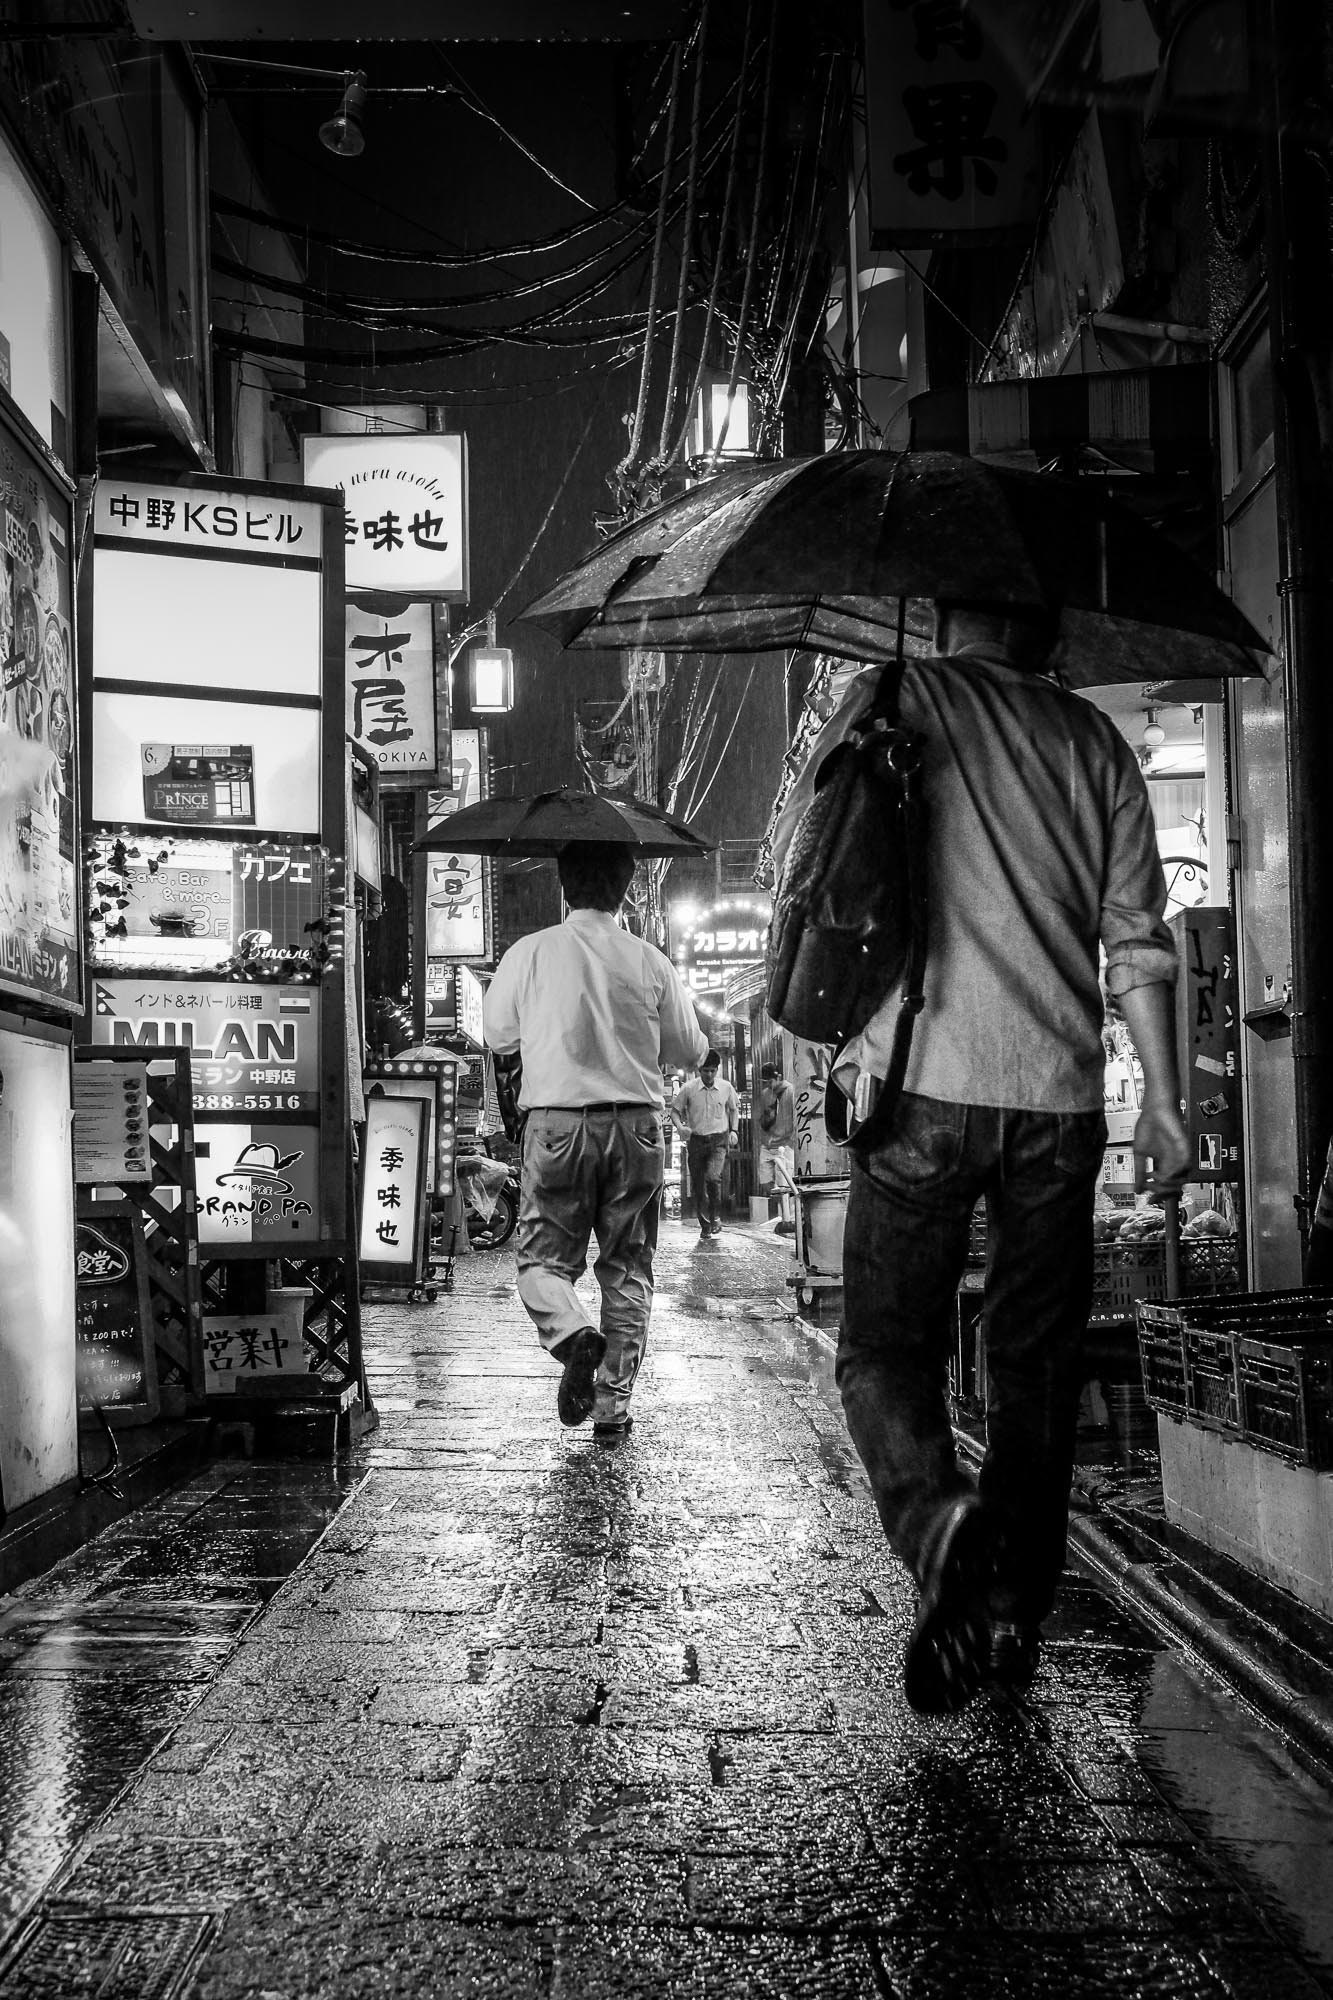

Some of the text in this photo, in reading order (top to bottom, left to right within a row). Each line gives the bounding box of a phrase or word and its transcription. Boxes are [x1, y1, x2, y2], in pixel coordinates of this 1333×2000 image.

[109, 493, 304, 544] 中野KSビル
[153, 790, 209, 806] PRINCE
[178, 871, 210, 886] Bar
[239, 852, 313, 885] カフェ
[161, 888, 176, 902] &
[190, 905, 229, 937] 3F
[111, 1019, 297, 1062] MILAN
[249, 1069, 297, 1085] 中野店
[281, 1197, 313, 1217] PA
[375, 1146, 405, 1247] 季味也
[204, 1327, 289, 1372] 営業中
